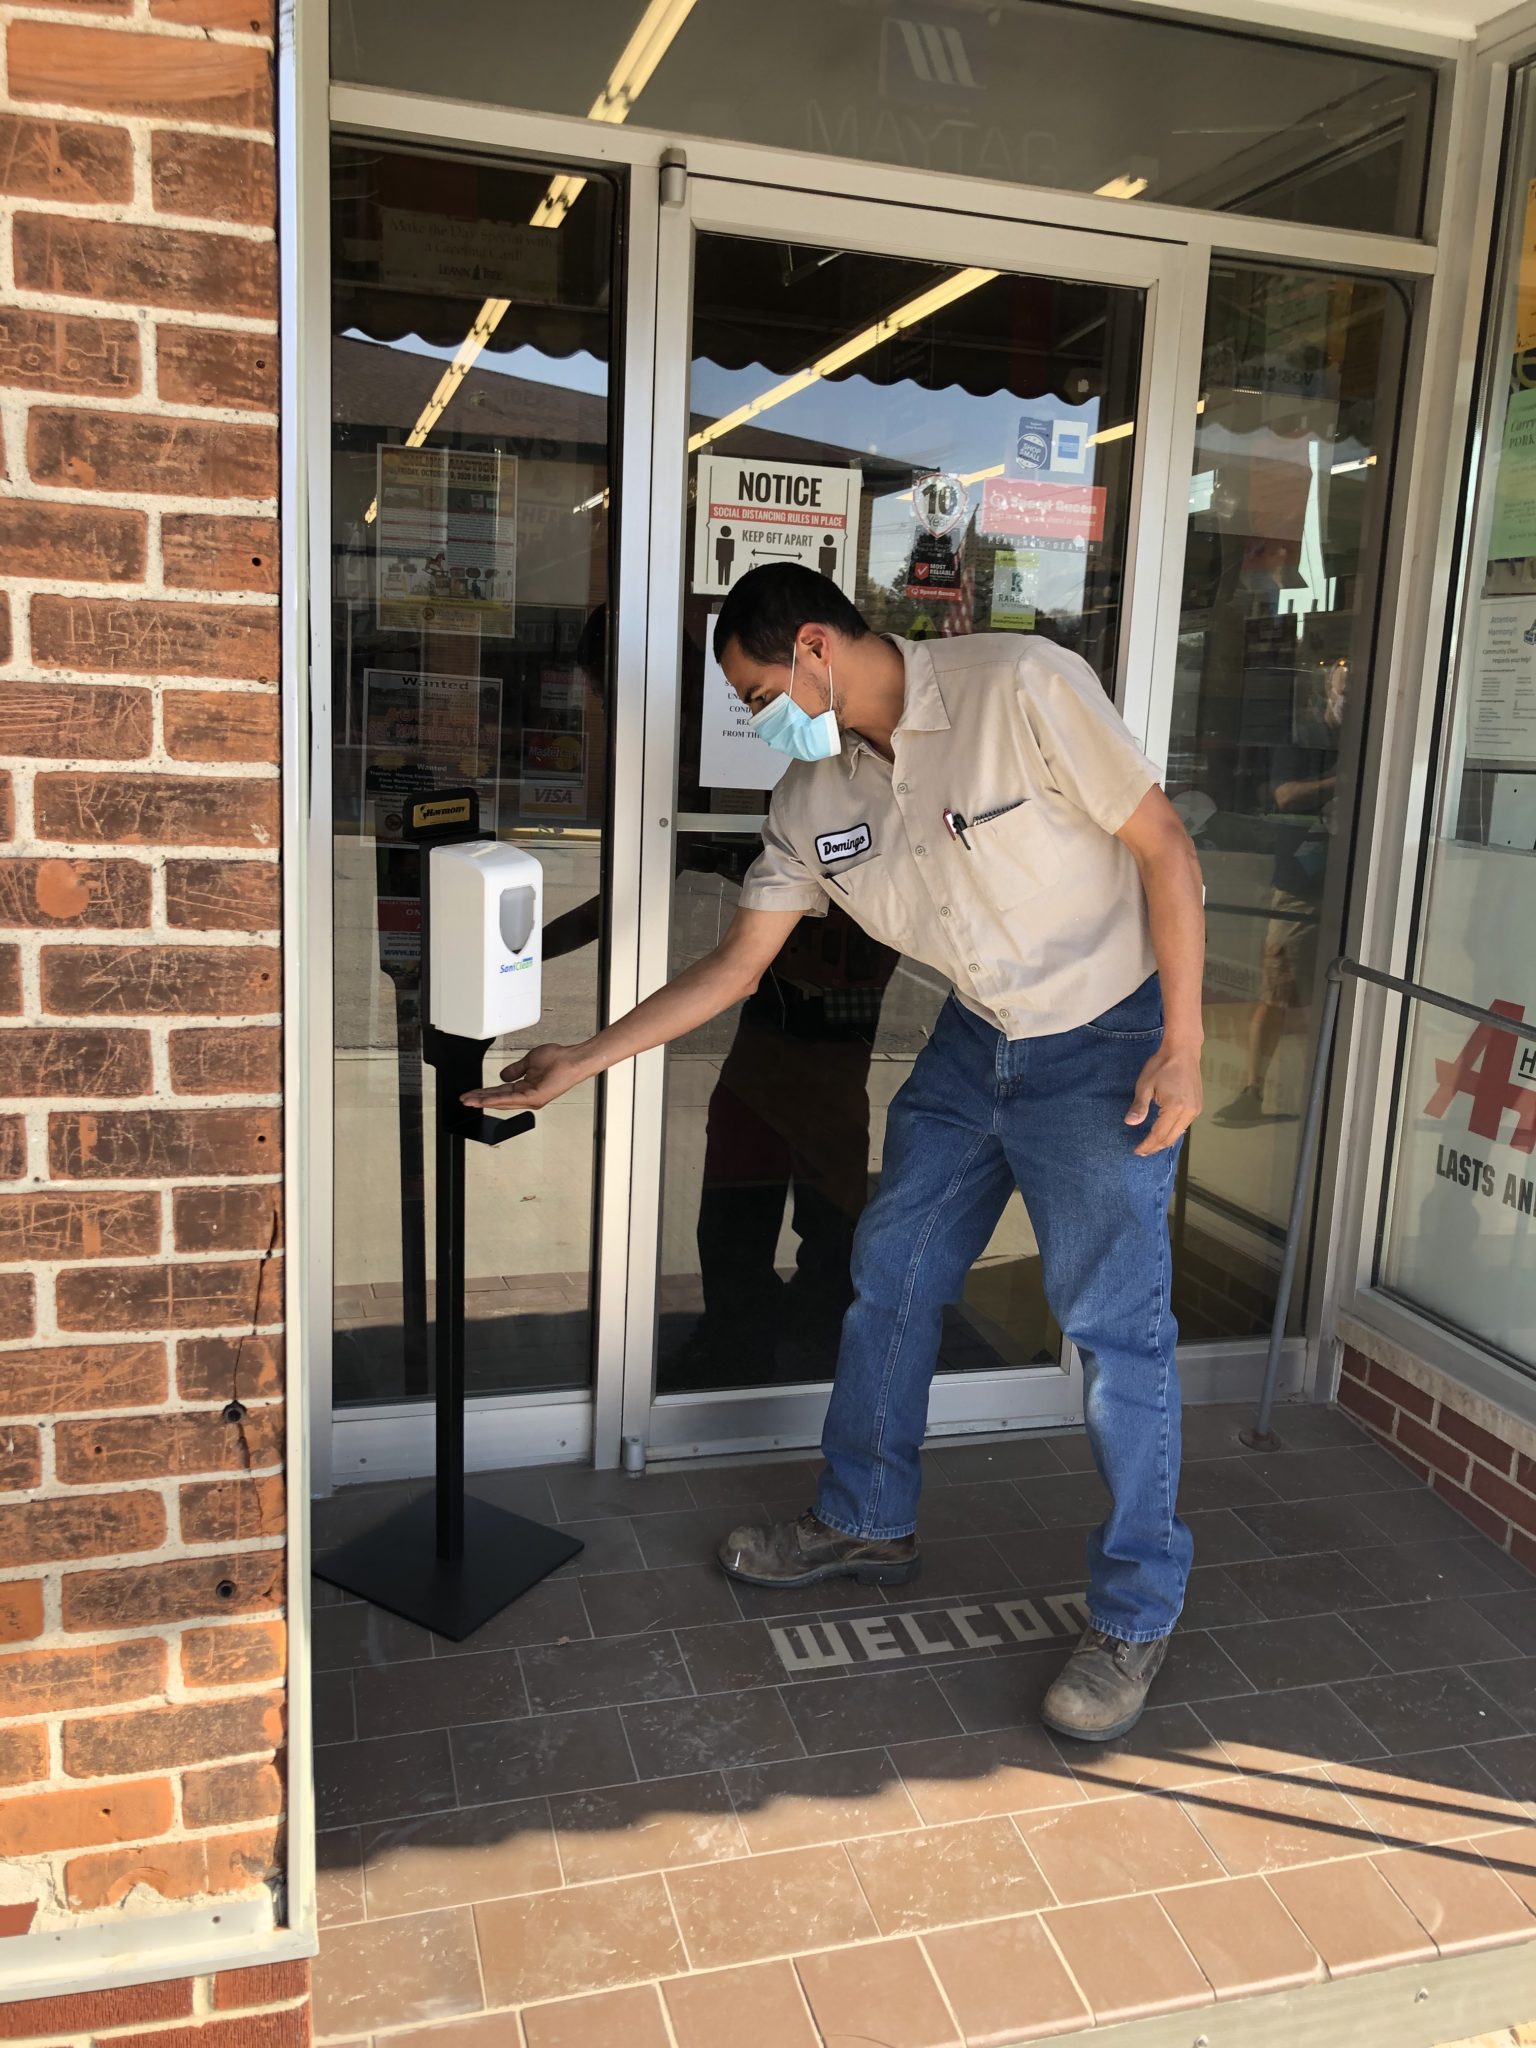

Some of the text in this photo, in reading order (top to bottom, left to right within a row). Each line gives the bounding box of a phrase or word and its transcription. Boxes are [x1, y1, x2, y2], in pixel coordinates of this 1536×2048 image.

[806, 99, 1057, 180] MAYTAG
[1019, 449, 1041, 461] SMALL
[1022, 442, 1042, 454] SHOP
[738, 471, 822, 507] NOTICE
[921, 484, 958, 516] 10
[1056, 500, 1097, 514] Queen
[713, 506, 843, 527] SOCIAL DISTANCING RULES IN PLACE
[927, 514, 948, 527] Year
[742, 529, 813, 547] KEEP 6FT APART
[929, 568, 956, 576] RELIABLE
[401, 677, 469, 690] Wanted
[722, 730, 744, 738] FROM
[416, 763, 448, 772] Wanted
[534, 788, 572, 803] VISA
[822, 834, 866, 856] Domingo
[499, 961, 533, 974] SaniClean
[1436, 1144, 1536, 1217] LASTS AN
[769, 1592, 1089, 1672] WELCOM
